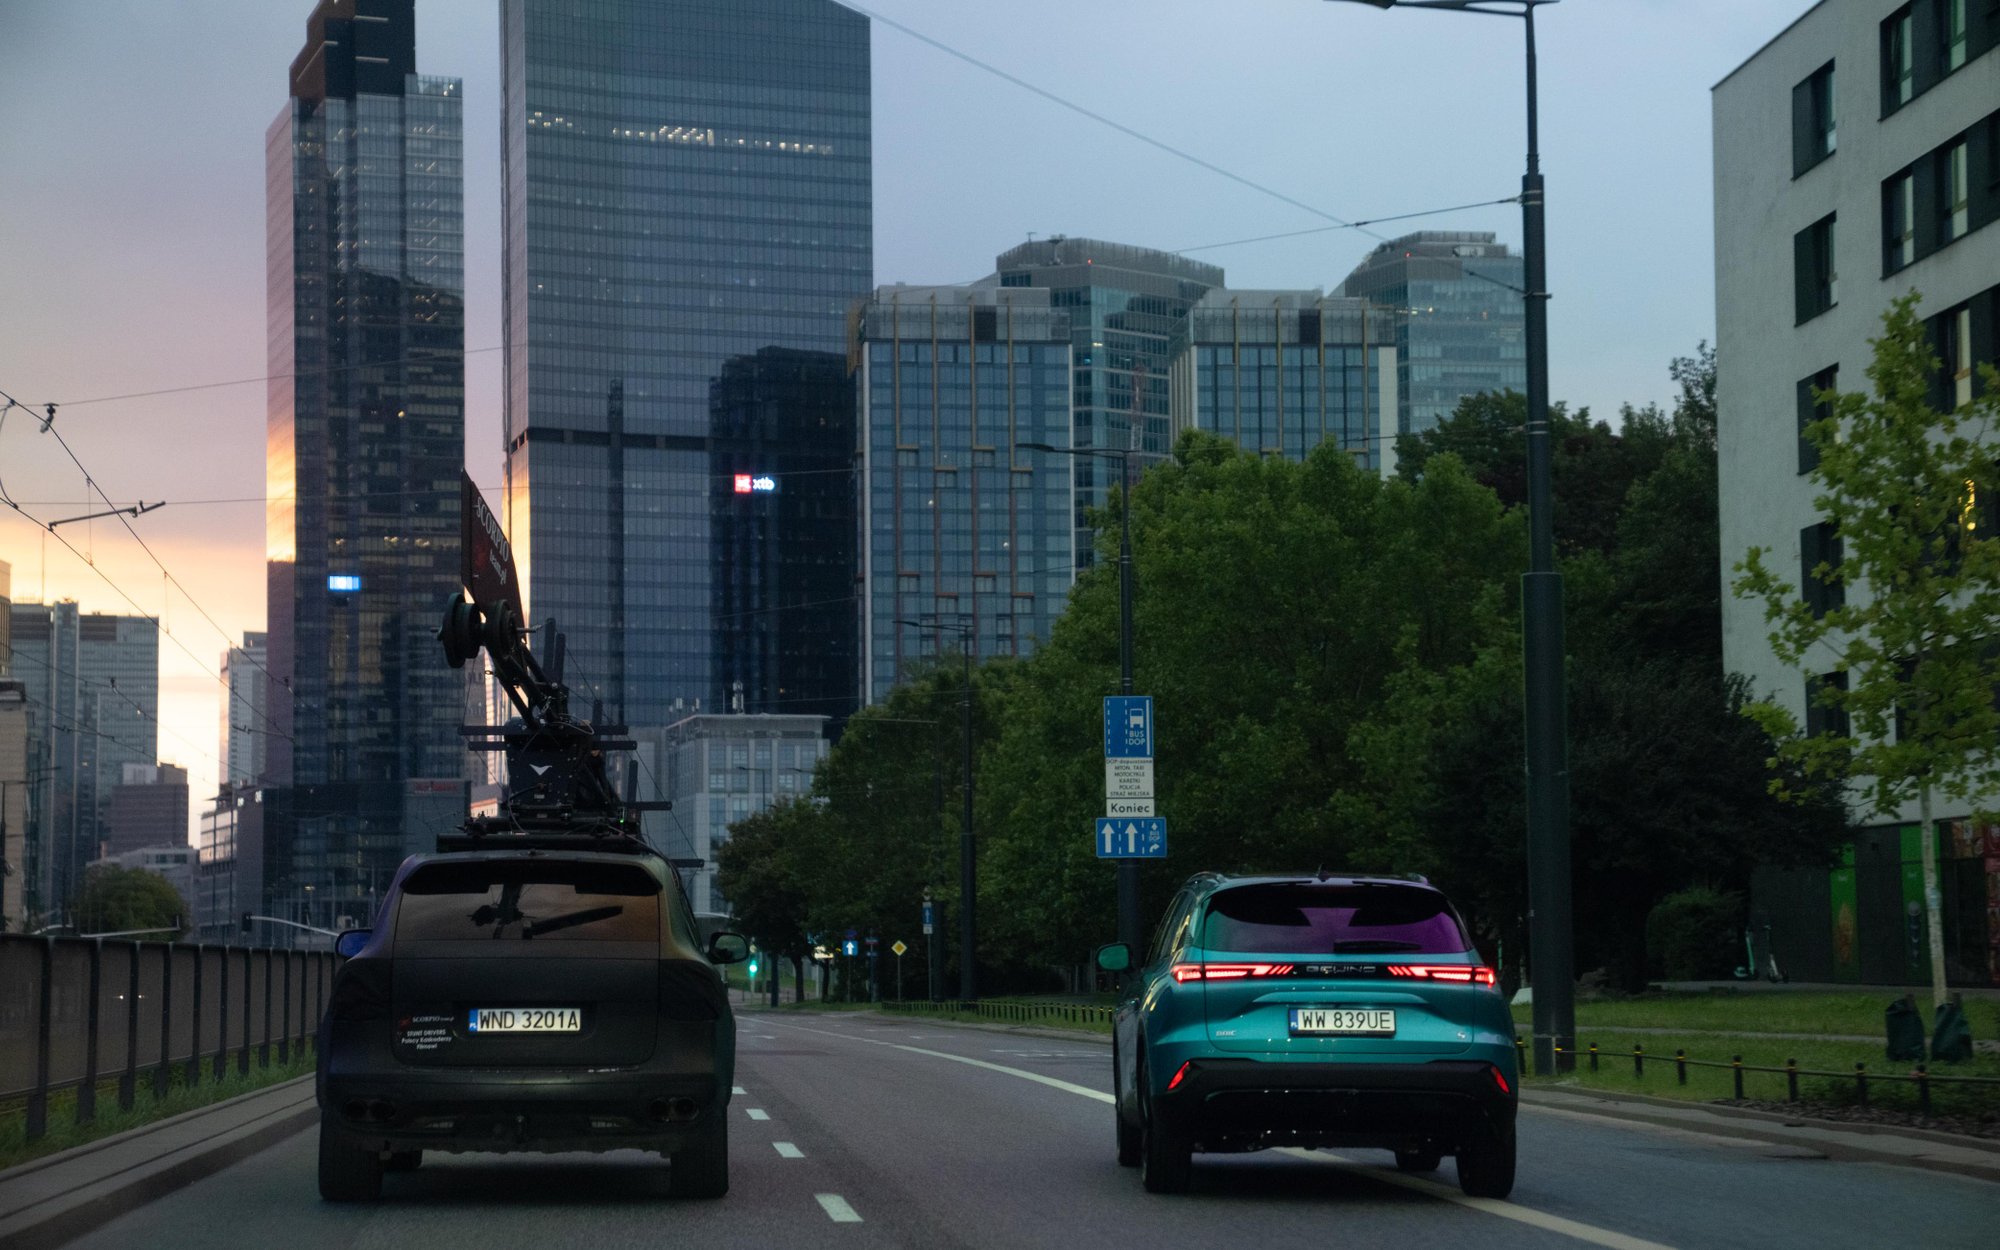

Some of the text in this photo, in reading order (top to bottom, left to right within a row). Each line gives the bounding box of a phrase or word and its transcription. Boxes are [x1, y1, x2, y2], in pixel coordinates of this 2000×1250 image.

[753, 477, 775, 490] xtb
[474, 496, 509, 562] SCORPIO
[1129, 730, 1144, 738] BUS
[1129, 738, 1146, 746] DOP
[1111, 803, 1150, 813] Koniec
[480, 1011, 515, 1029] WND
[522, 1011, 578, 1029] 3201A
[1302, 1011, 1326, 1028] WW
[1334, 1012, 1391, 1029] 839UE
